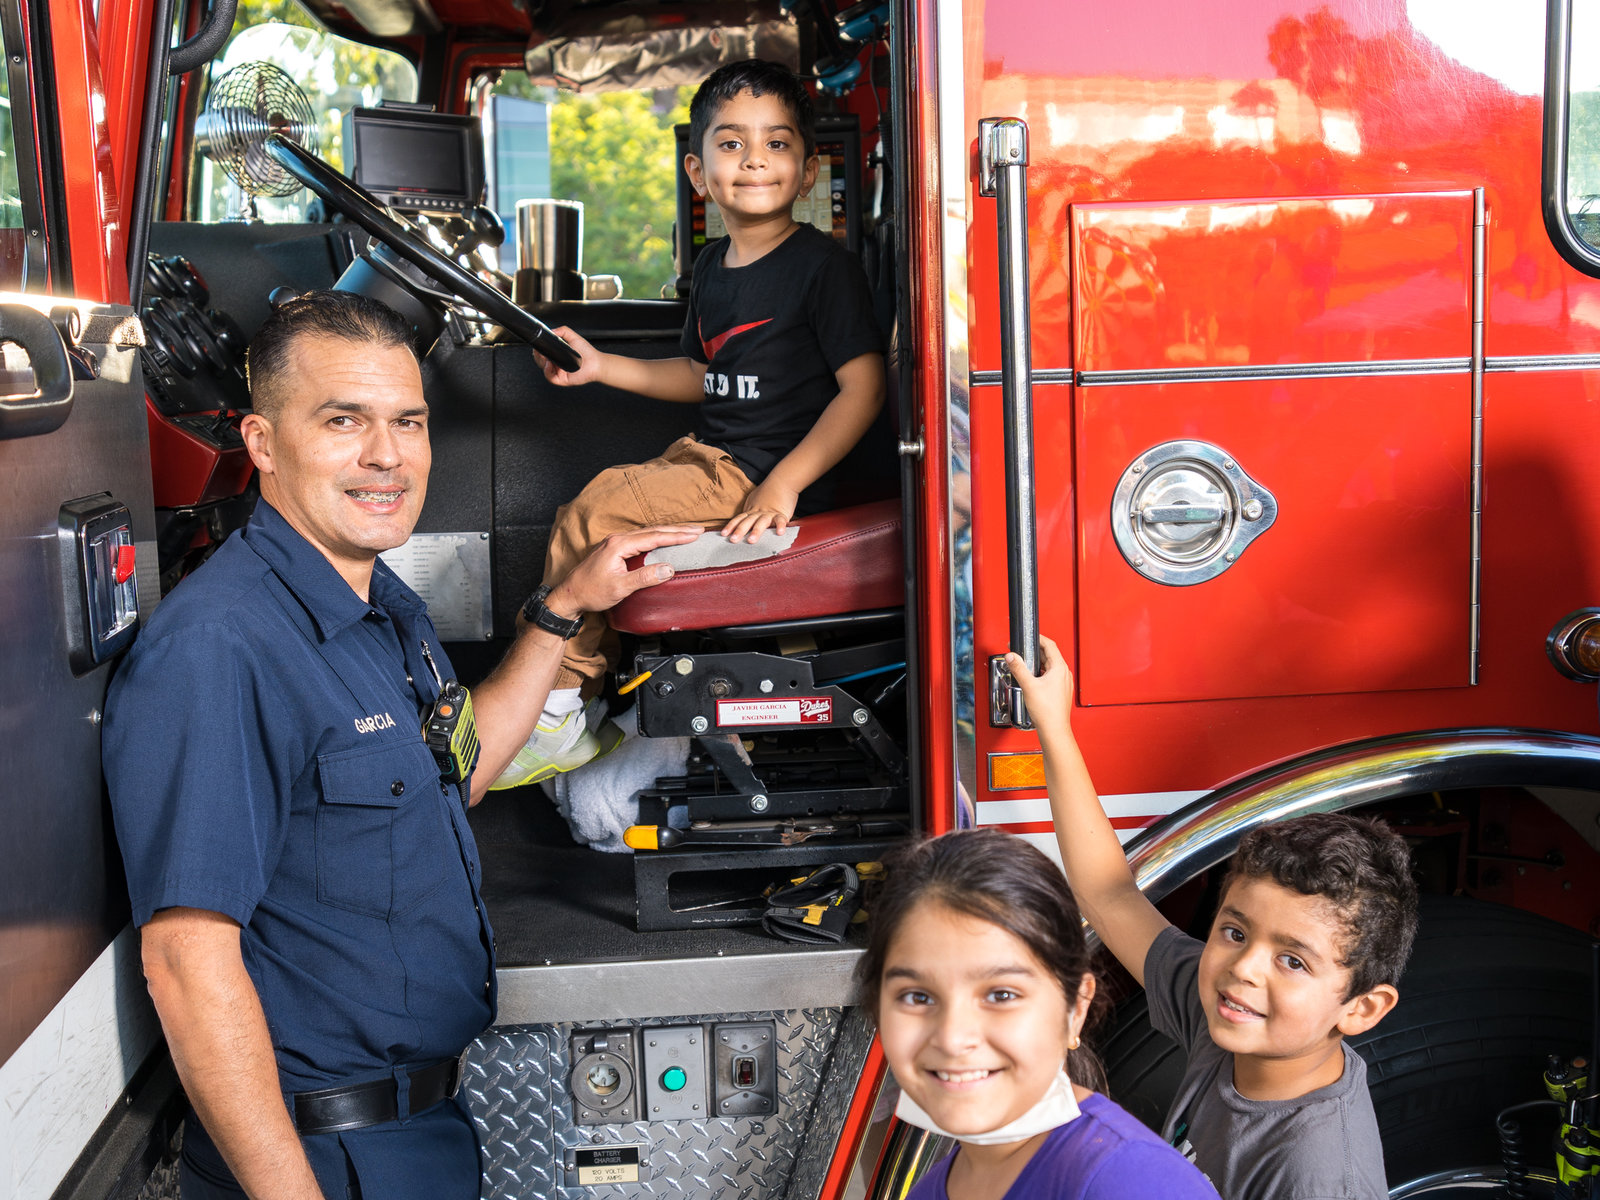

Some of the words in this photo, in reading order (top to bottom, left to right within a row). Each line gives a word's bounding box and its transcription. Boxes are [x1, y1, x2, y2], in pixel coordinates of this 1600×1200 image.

[737, 375, 760, 399] IT.
[800, 699, 830, 713] Dukes
[354, 712, 397, 734] GARCIA
[816, 713, 829, 722] 35
